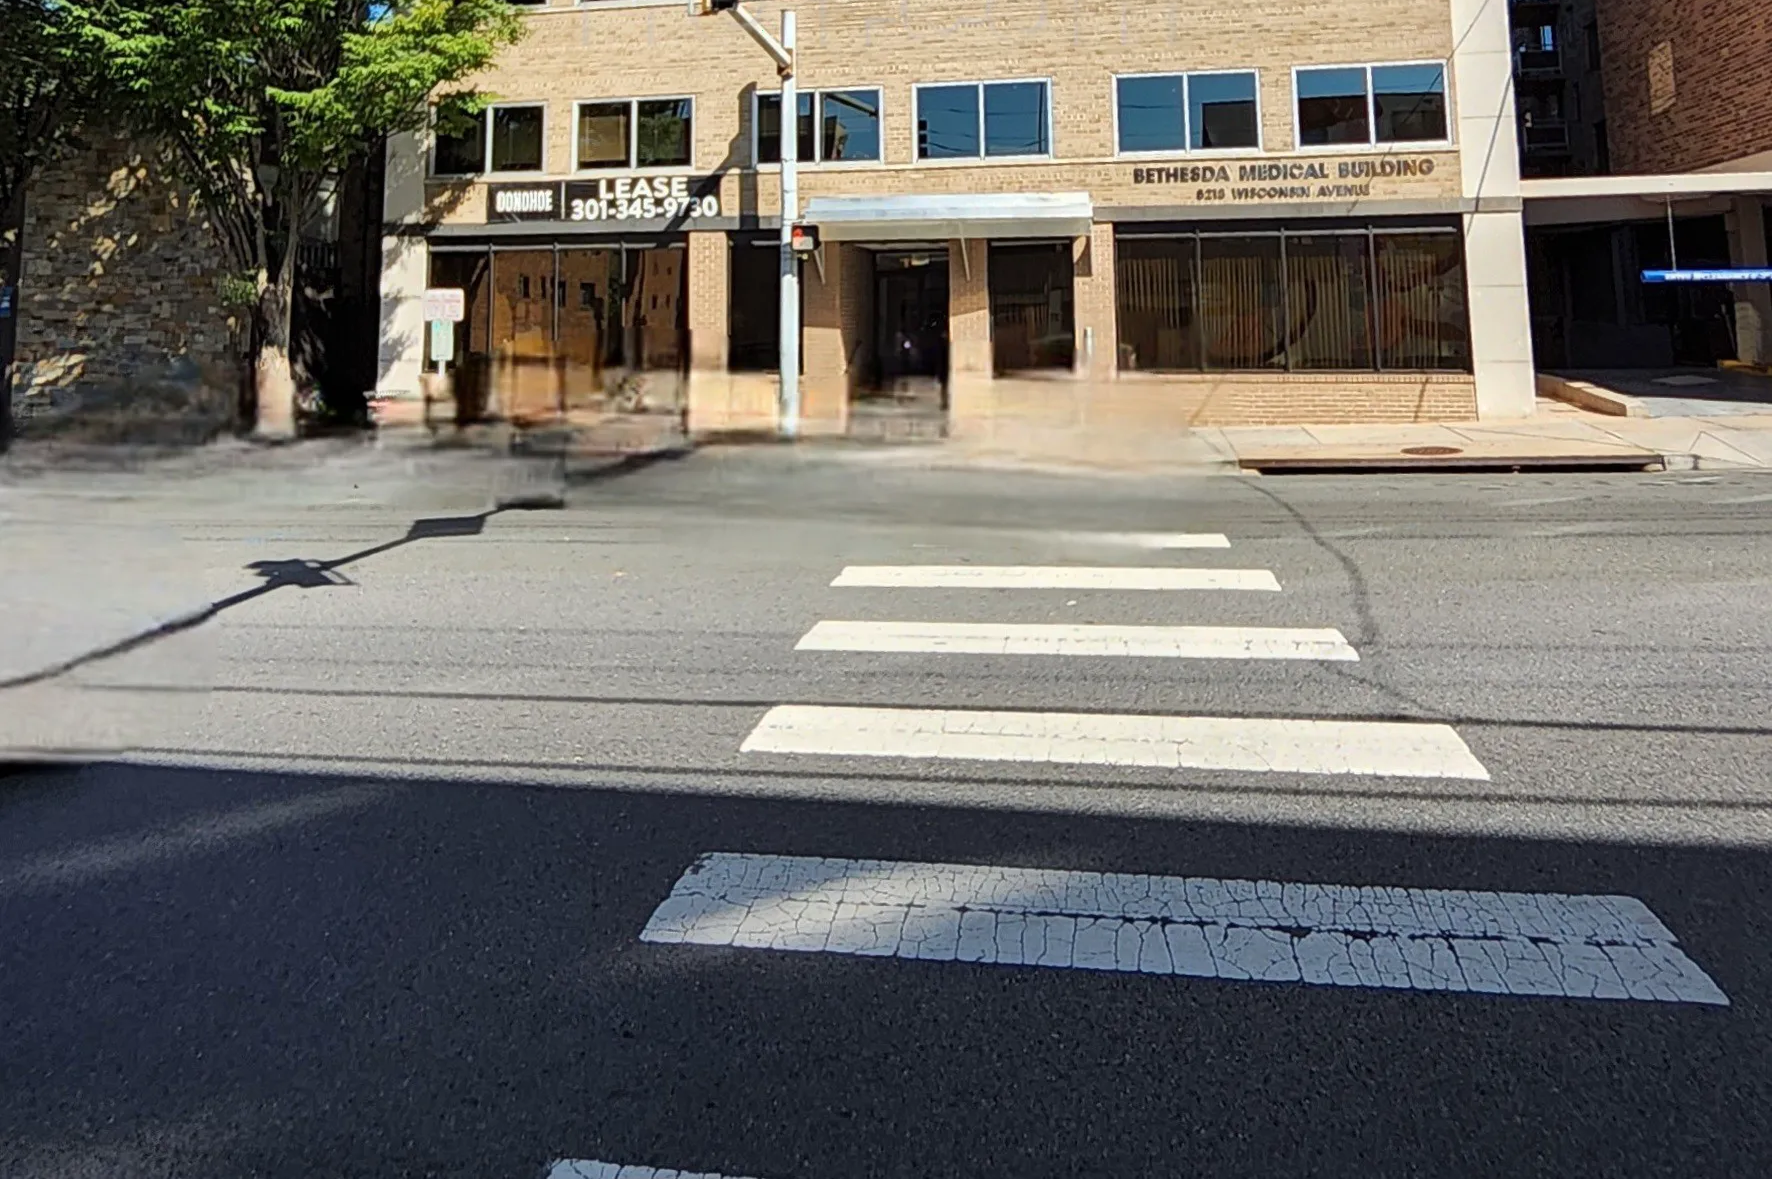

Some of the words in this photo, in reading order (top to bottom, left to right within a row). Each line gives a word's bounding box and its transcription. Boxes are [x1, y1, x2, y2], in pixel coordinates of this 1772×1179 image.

[1133, 164, 1231, 185] BETHESDA
[1239, 161, 1329, 182] MEDICAL
[1338, 158, 1436, 179] BUILDING
[600, 176, 689, 199] LEASE
[1231, 186, 1311, 200] WISCONSIN
[1316, 184, 1371, 198] AVENUE
[571, 196, 719, 220] 301-345-9730
